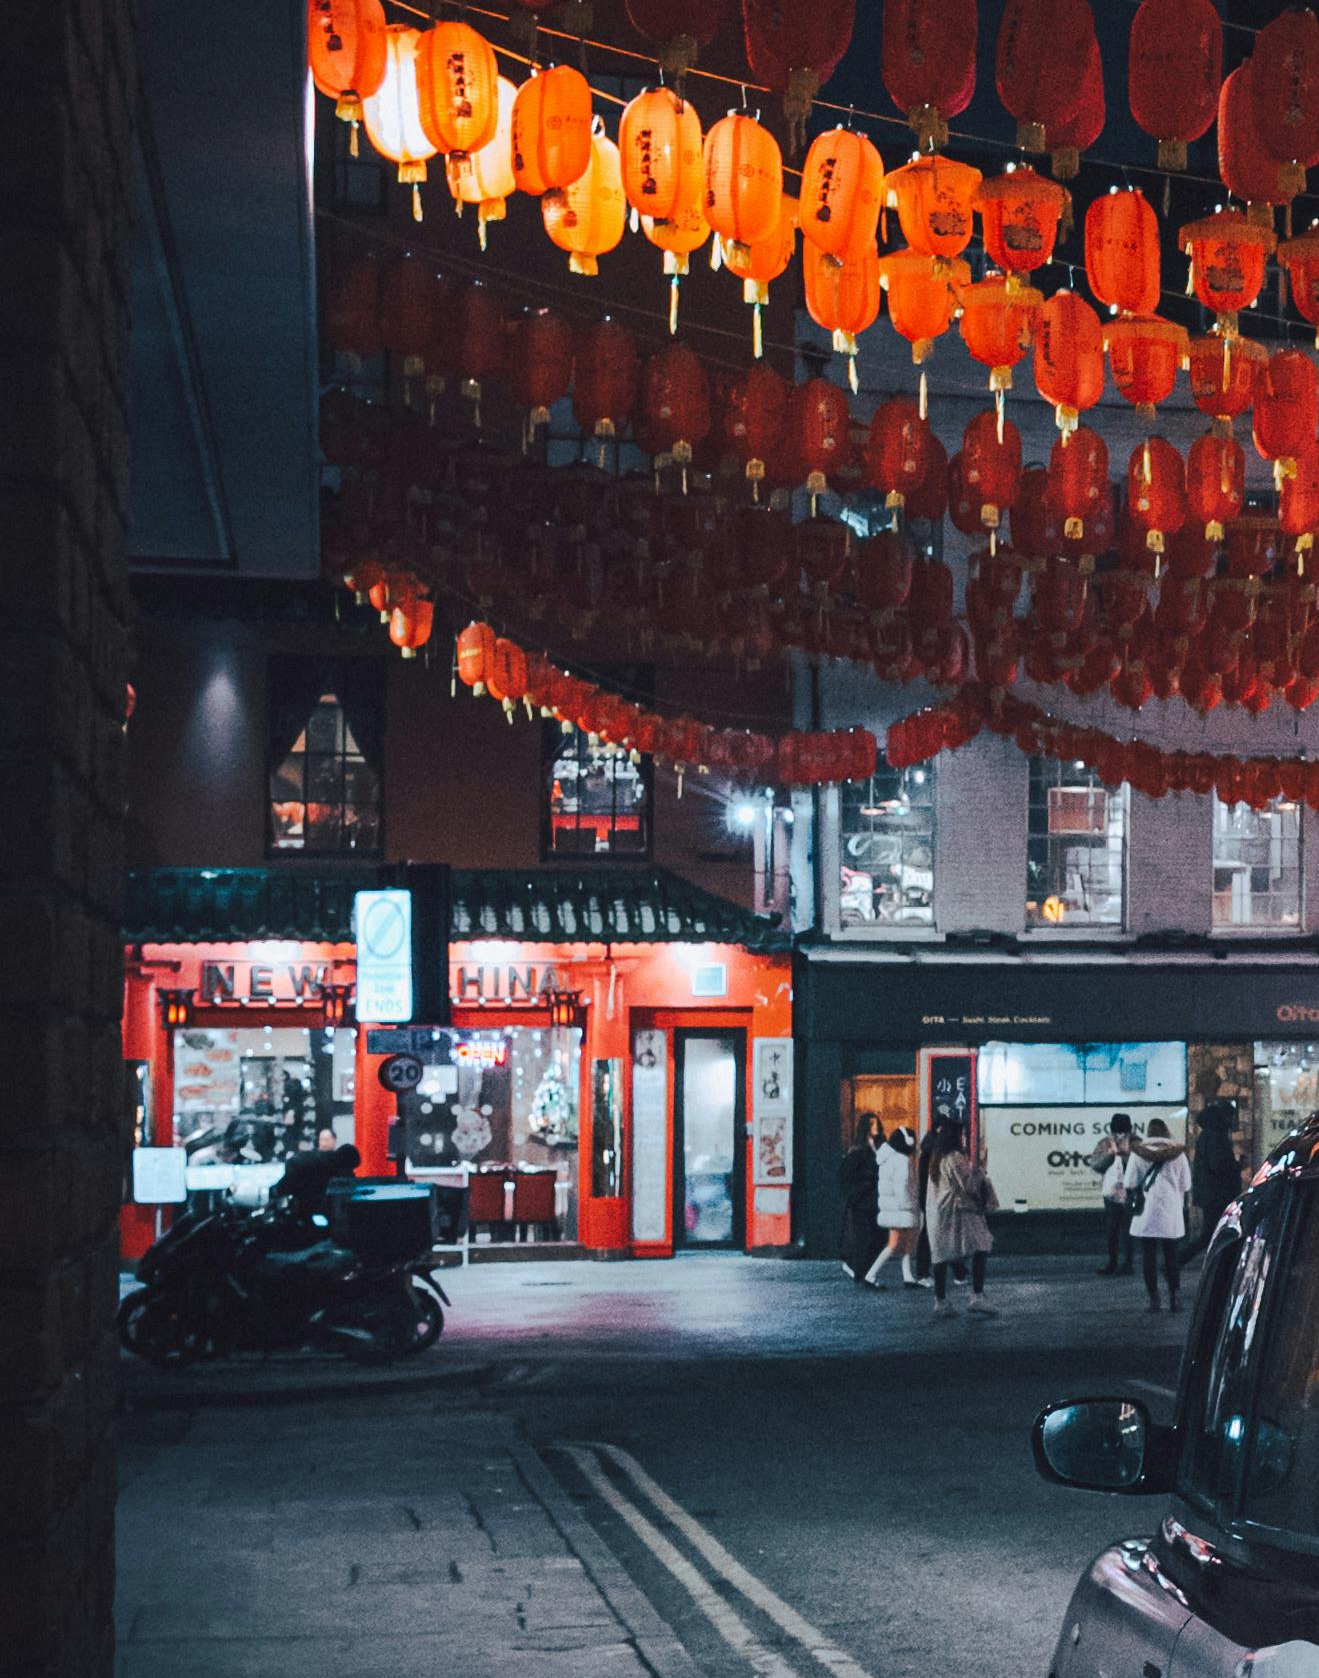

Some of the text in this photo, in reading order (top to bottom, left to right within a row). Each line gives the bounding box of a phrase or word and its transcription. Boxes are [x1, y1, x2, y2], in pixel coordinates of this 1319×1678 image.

[204, 964, 567, 998] NEW HINA
[456, 1042, 507, 1067] OPEN
[387, 1065, 417, 1082] 20
[1010, 1122, 1146, 1136] COMING SN
